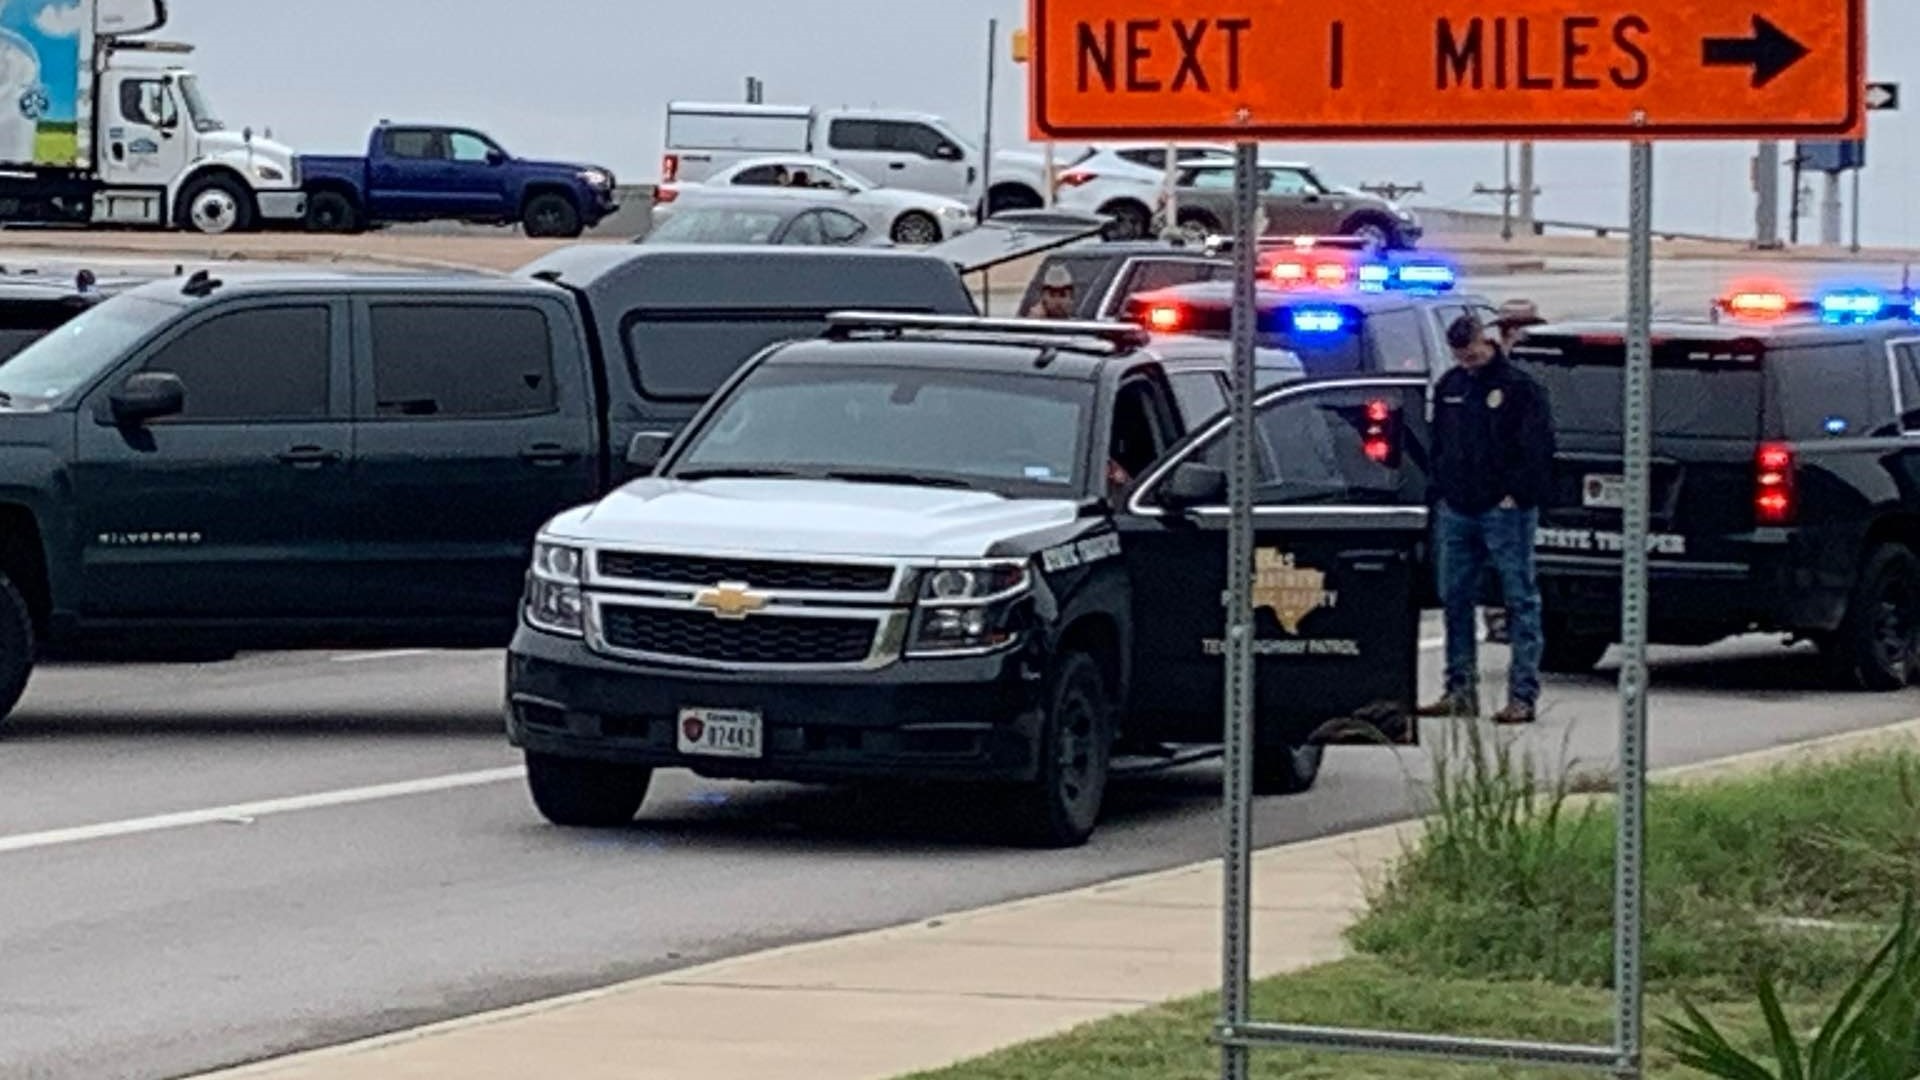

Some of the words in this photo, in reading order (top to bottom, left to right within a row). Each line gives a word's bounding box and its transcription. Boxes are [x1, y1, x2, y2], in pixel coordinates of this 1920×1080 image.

[1076, 18, 1252, 93] NEXT
[1436, 15, 1650, 90] MILES
[1535, 526, 1592, 549] STATE
[1594, 531, 1686, 554] TRPER
